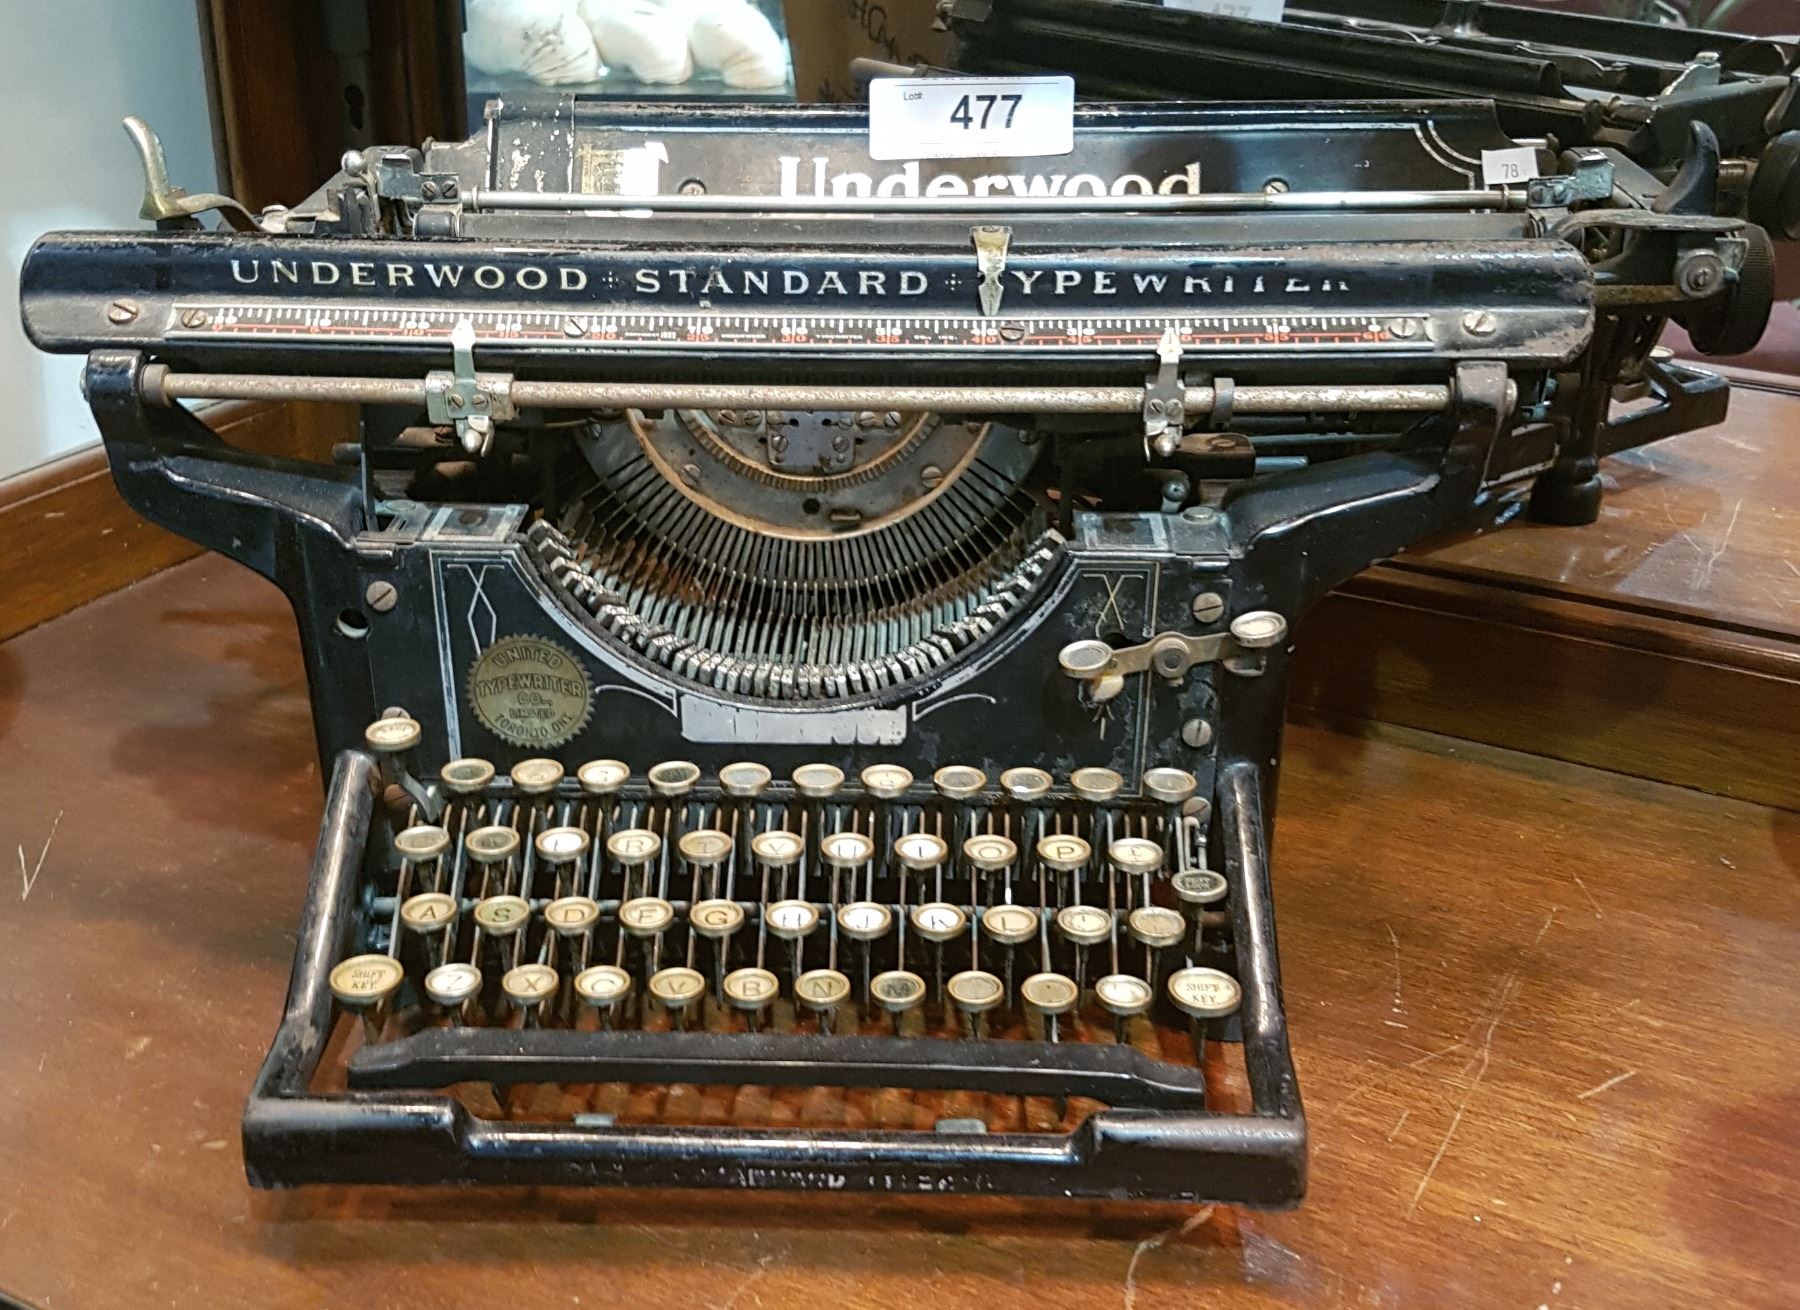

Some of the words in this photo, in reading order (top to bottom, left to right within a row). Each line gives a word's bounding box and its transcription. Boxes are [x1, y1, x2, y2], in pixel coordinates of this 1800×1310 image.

[950, 94, 1023, 130] 477
[778, 156, 1201, 196] Underwood
[1501, 163, 1519, 178] 78
[231, 259, 588, 292] UNDERWOOD
[635, 268, 929, 297] STANDARD
[1264, 333, 1289, 342] 55
[1363, 331, 1390, 340] 60
[491, 646, 564, 669] UNITED
[477, 673, 584, 698] TYPEWRITER
[494, 713, 549, 738] TORONTO
[697, 841, 714, 854] T
[769, 843, 785, 855] Y
[979, 847, 1002, 859] O
[1056, 846, 1075, 860] P
[418, 904, 437, 921] A
[491, 907, 512, 923] S
[563, 908, 585, 923] D
[638, 908, 657, 924] F
[705, 911, 728, 926] G
[351, 969, 386, 979] SHIFT
[447, 974, 463, 991] Z
[523, 976, 542, 992] X
[667, 981, 685, 995] V
[743, 980, 761, 996] B
[812, 981, 833, 996] N
[1186, 982, 1220, 993] SHIFT
[1193, 993, 1216, 1004] KEY
